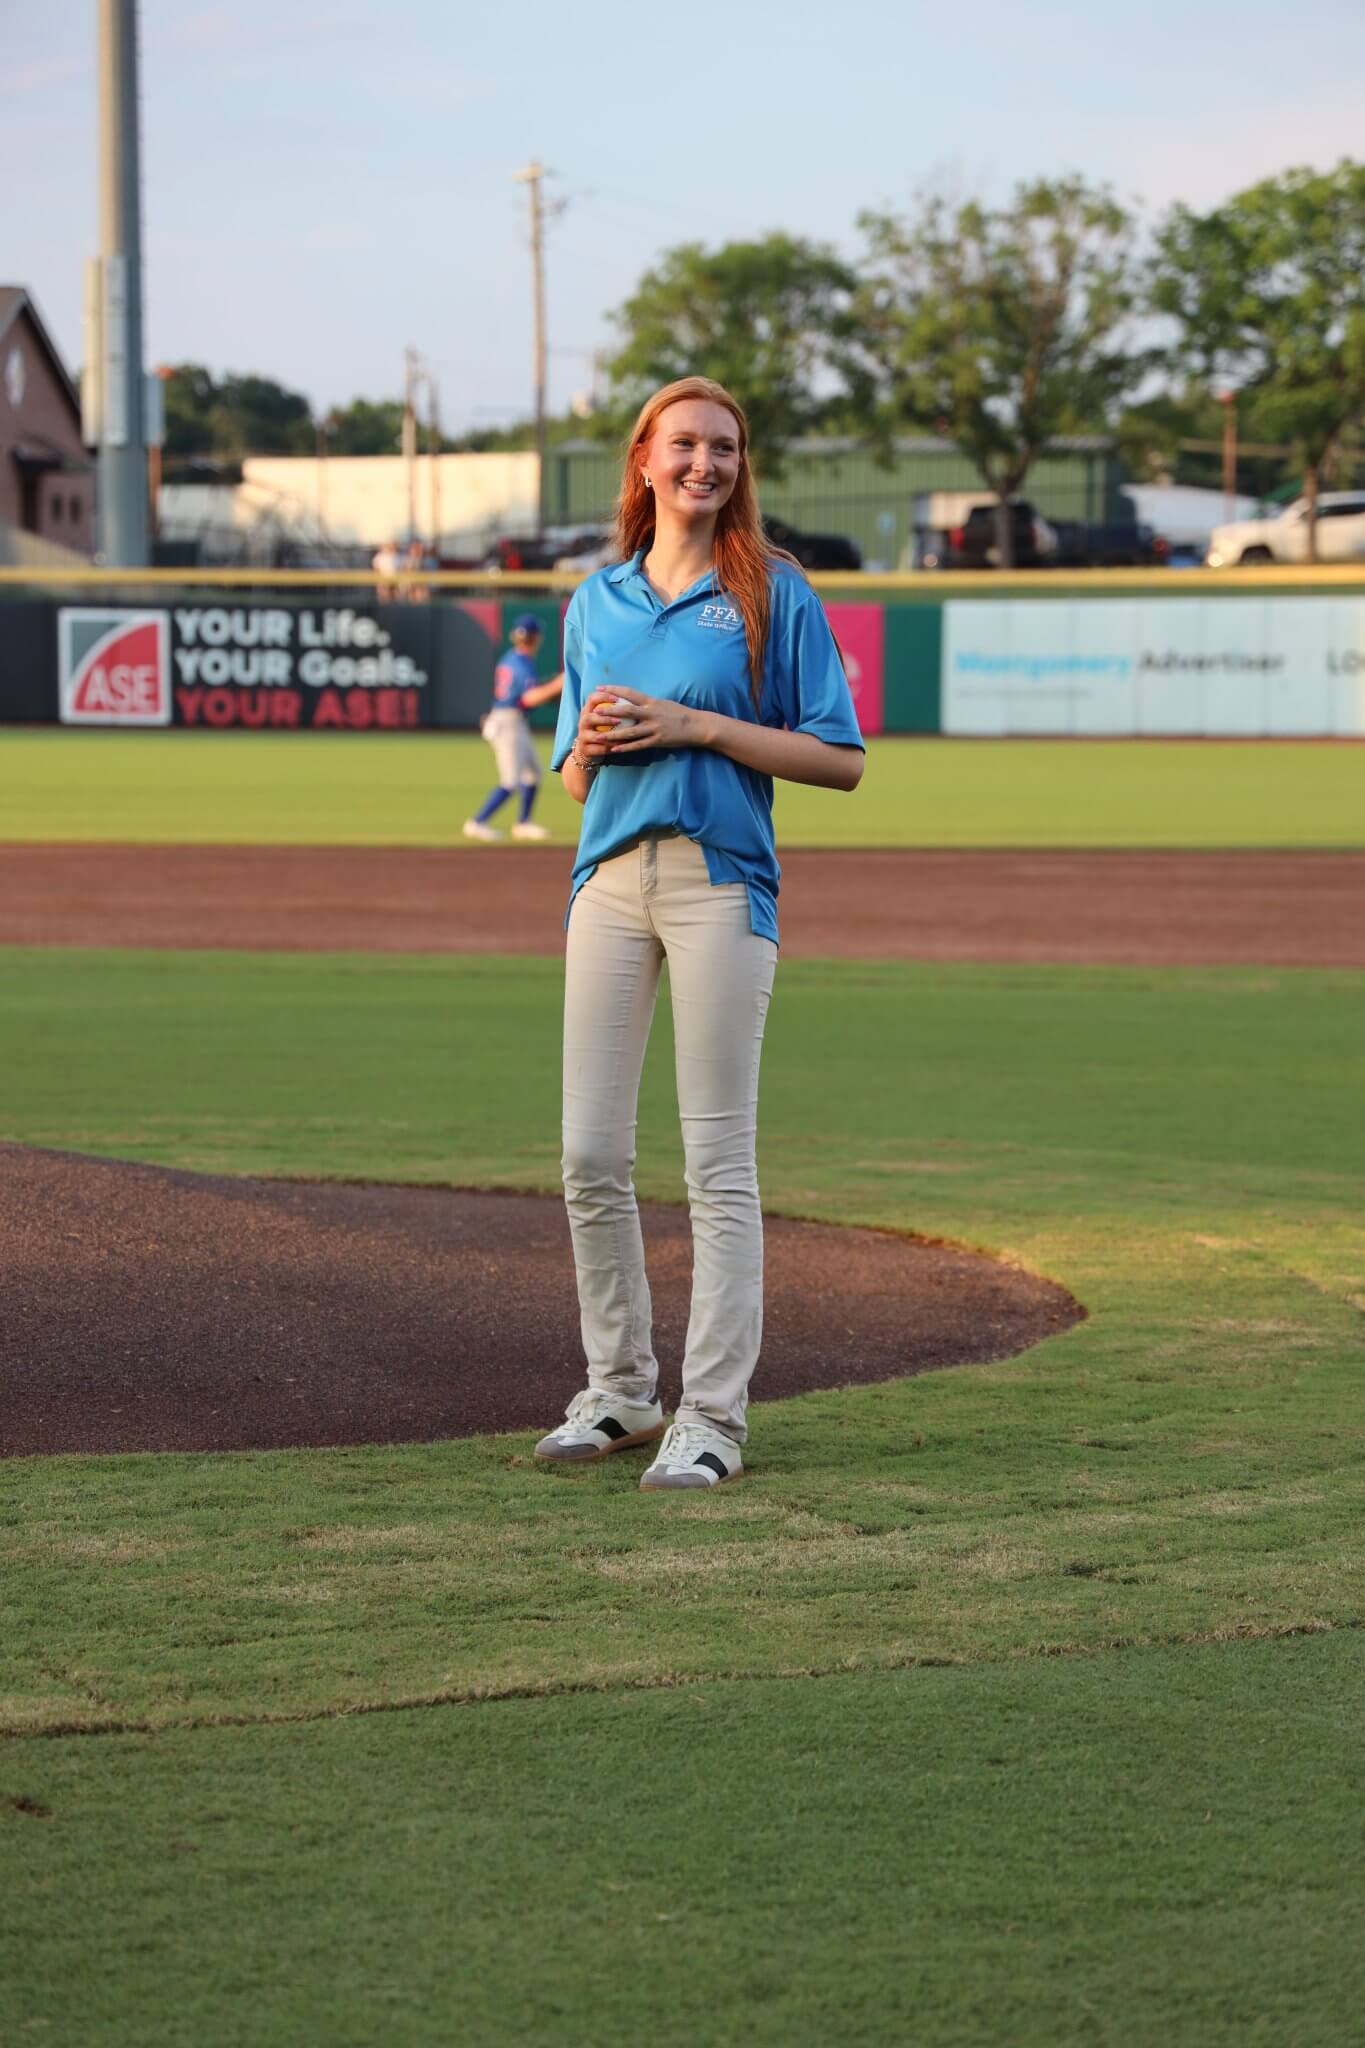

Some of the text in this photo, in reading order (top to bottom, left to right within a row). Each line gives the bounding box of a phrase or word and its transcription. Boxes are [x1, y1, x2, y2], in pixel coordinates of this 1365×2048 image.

[176, 610, 389, 646] YOUR Life.
[701, 605, 738, 622] FFA
[176, 650, 426, 686] YOUR Goals.
[956, 649, 1285, 679] Montgomery Advertiser
[1327, 649, 1365, 675] LO
[84, 666, 156, 712] ASE
[177, 690, 418, 726] YOUR ASE!
